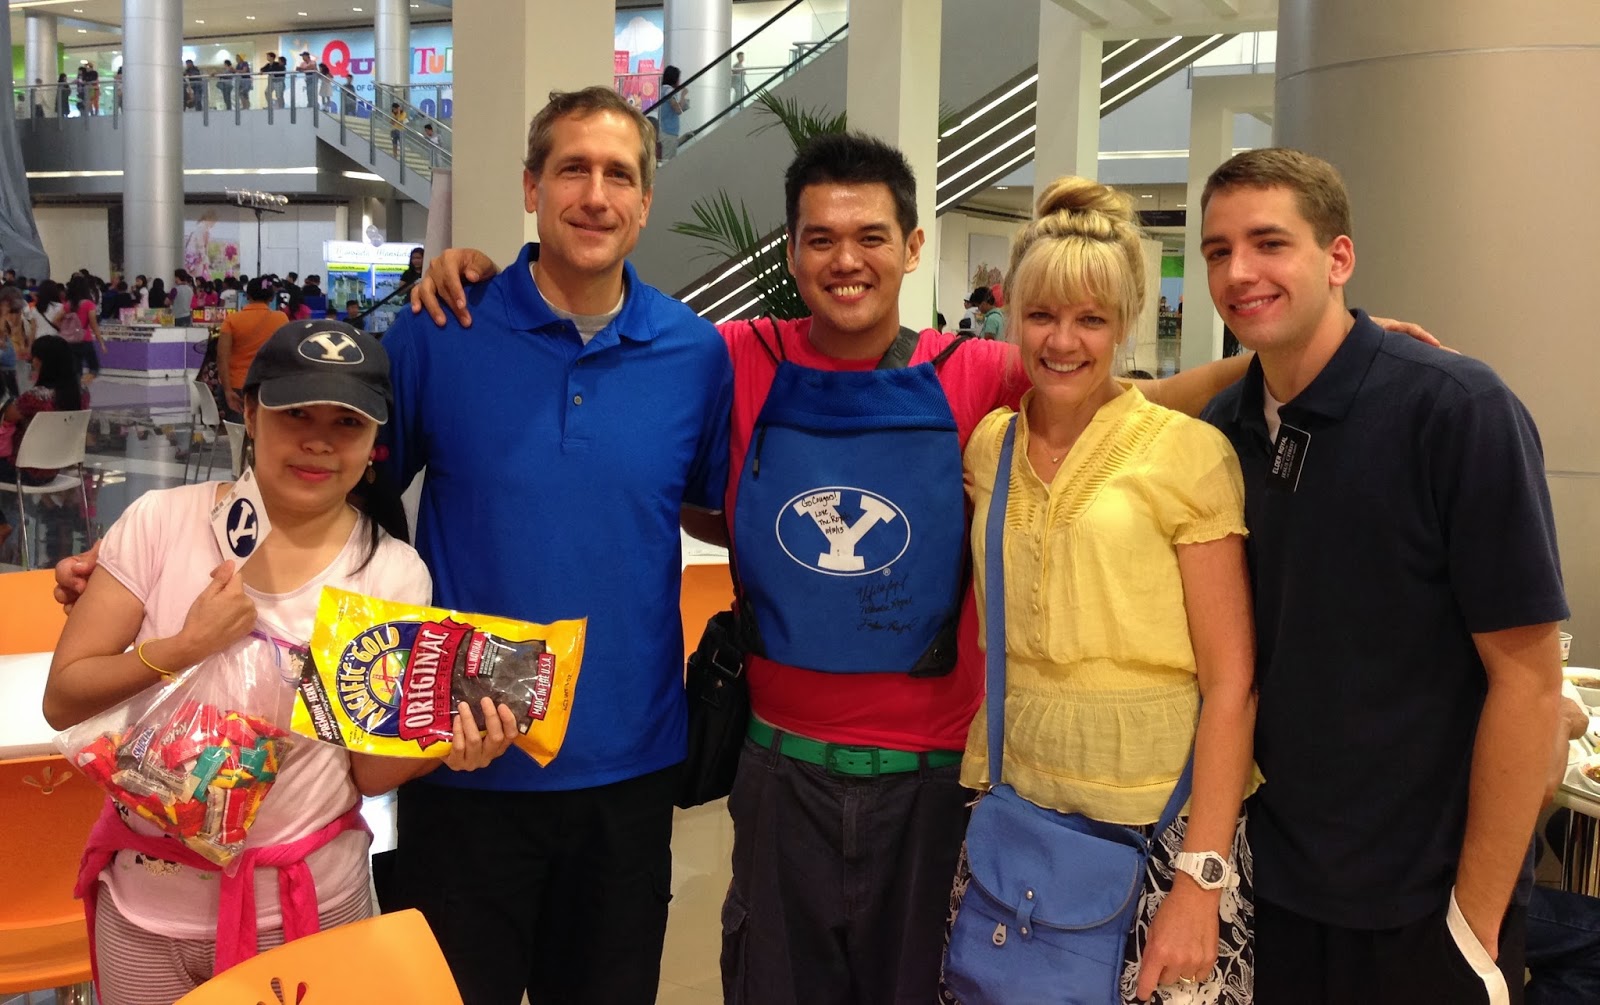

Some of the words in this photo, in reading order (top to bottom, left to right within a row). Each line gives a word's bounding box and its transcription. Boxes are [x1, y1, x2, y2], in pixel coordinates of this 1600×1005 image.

[308, 333, 357, 360] Y
[1272, 454, 1282, 475] ELDER
[1277, 436, 1289, 455] ROYAL
[802, 497, 813, 507] Go
[229, 500, 256, 549] Y
[793, 491, 897, 571] Y
[351, 626, 400, 663] GOLD
[440, 639, 455, 679] JERKY
[469, 640, 483, 664] NATURAL
[405, 629, 450, 728] ORIGINAL
[467, 663, 477, 674] ALL
[302, 682, 318, 703] JERKY
[341, 662, 386, 729] PACIFIC
[436, 684, 445, 718] BEEF
[532, 696, 545, 716] MADE
[537, 687, 547, 697] IN
[312, 703, 333, 739] PREMIUM
